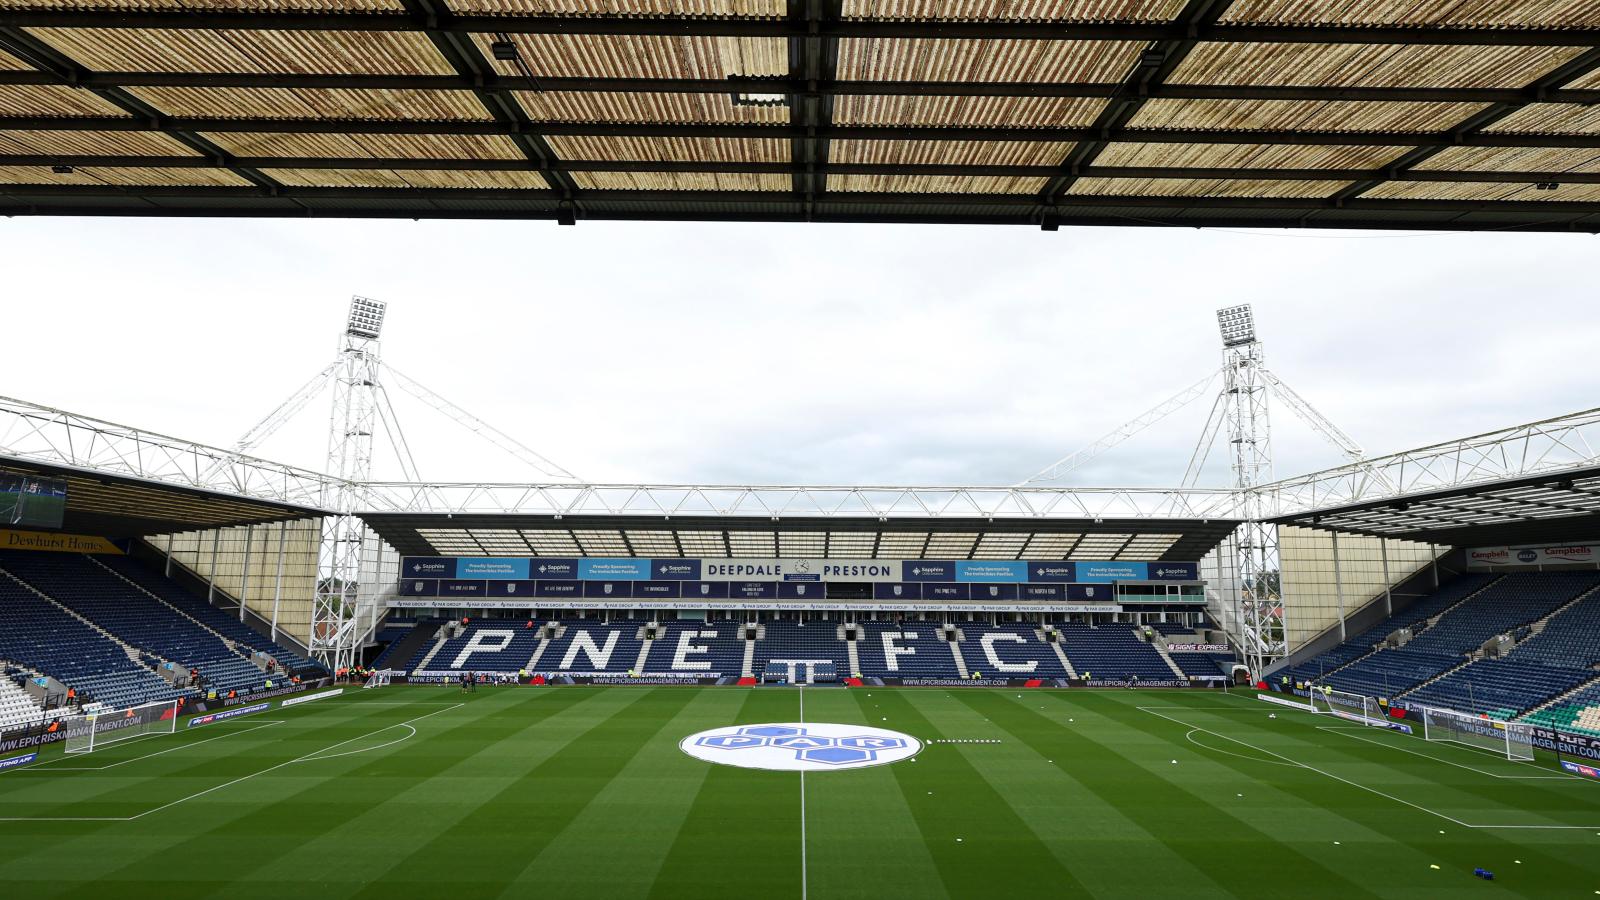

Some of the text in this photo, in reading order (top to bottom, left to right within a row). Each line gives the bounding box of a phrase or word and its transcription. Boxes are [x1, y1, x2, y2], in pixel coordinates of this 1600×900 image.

[9, 533, 103, 552] Dewhurst Homes
[1545, 546, 1591, 556] Campbells
[708, 565, 890, 576] DEEPDALE PRESTON
[1293, 689, 1374, 711] WWW.EPCRISMANAGEMENT.COM
[18, 756, 32, 764] APP
[1565, 763, 1578, 772] sky
